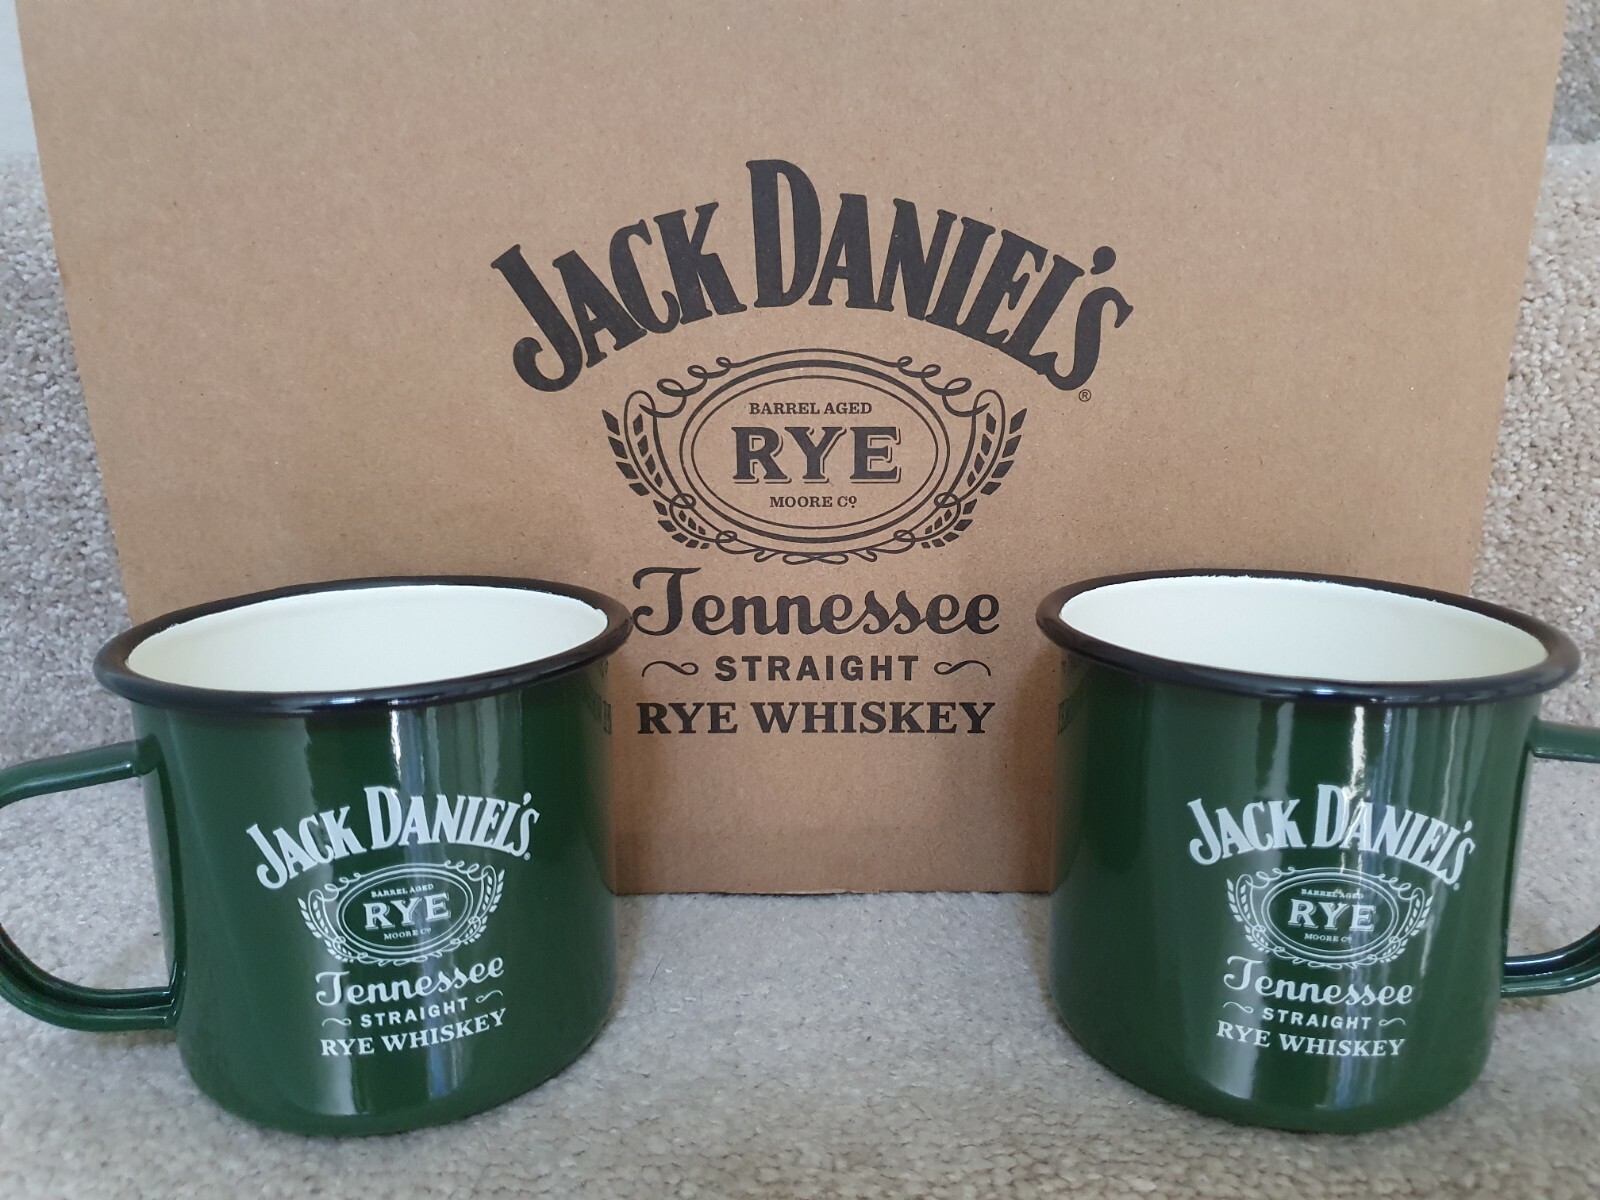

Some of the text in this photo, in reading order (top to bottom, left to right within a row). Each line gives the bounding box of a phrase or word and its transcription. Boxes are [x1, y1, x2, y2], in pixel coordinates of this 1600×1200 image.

[491, 159, 1134, 392] JACK DANIEL'S
[749, 402, 872, 415] BARREL AGED
[731, 426, 901, 484] RYE
[769, 496, 833, 508] MOORE
[632, 567, 1000, 636] Tennessee
[714, 655, 919, 682] STRAIGHT
[637, 702, 738, 735] RYE
[750, 702, 995, 735] WHISKEY
[246, 785, 540, 890] JACK DANIEL'S
[1187, 783, 1476, 885] JACK DANIEL'S
[371, 883, 434, 898] BARREL AGED
[1301, 888, 1338, 898] BARREL
[362, 892, 452, 931] RYE
[1287, 899, 1377, 932] RYE
[383, 929, 418, 941] MOORE
[1304, 933, 1340, 942] MOORE
[314, 957, 505, 1007] Tennessee
[1223, 955, 1413, 1006] Tennessee
[360, 997, 468, 1029] STRAIGHT
[1262, 1007, 1372, 1030] STRAIGHT
[320, 1007, 507, 1057] RYE WHISKEY
[1216, 1020, 1406, 1058] RYE WHISKEY
